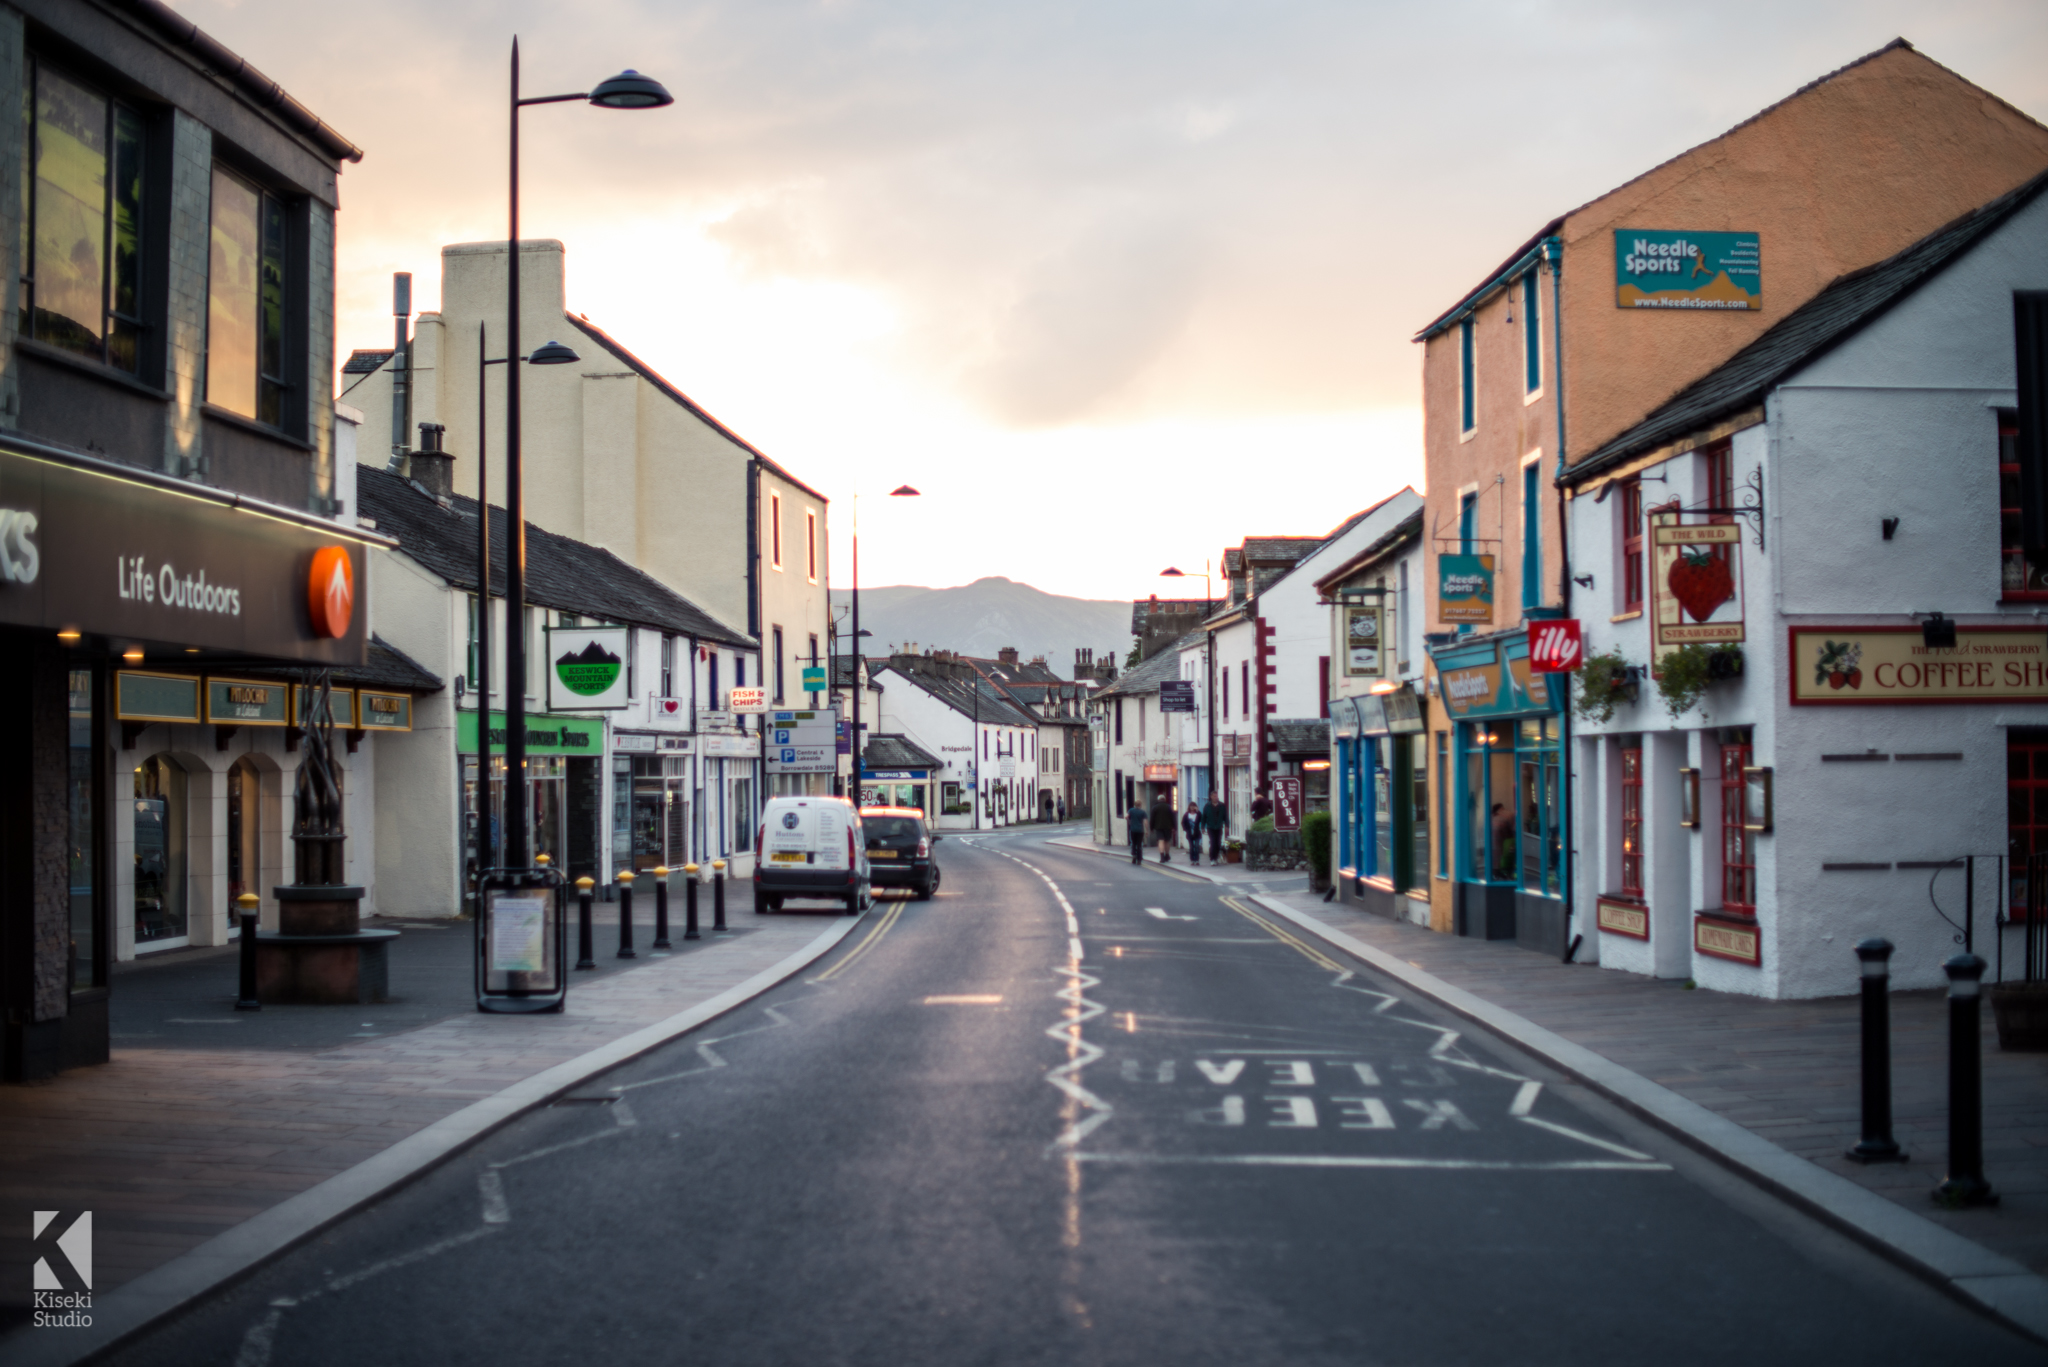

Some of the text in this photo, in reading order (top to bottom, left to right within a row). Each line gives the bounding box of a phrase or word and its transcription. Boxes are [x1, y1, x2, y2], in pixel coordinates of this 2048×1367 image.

[1634, 239, 1697, 257] Needle
[1625, 254, 1680, 275] Sports
[1634, 298, 1747, 308] www.NeedleSports.com
[1671, 530, 1725, 540] THE WILD
[119, 556, 240, 616] Life Outdoors
[1448, 575, 1484, 584] Needle
[1443, 583, 1473, 593] Sports
[1664, 627, 1740, 639] STRAWBERRY
[1533, 627, 1579, 668] illy
[1911, 646, 1932, 654] THE
[1973, 645, 2042, 654] STRAWBERRY
[564, 674, 613, 683] MOUNTAIN
[568, 666, 609, 675] KESWICK
[1874, 662, 2048, 688] COFFEE SH
[572, 682, 606, 691] SPORTS
[230, 687, 268, 703] PITLOCHRY
[659, 701, 665, 713] I
[1276, 782, 1296, 824] BOOKS
[1604, 908, 1643, 929] COFFEE SHOP
[1701, 928, 1733, 949] HOMEMADE
[1120, 1060, 1457, 1086] CLEAR
[1184, 1094, 1480, 1131] KEEP
